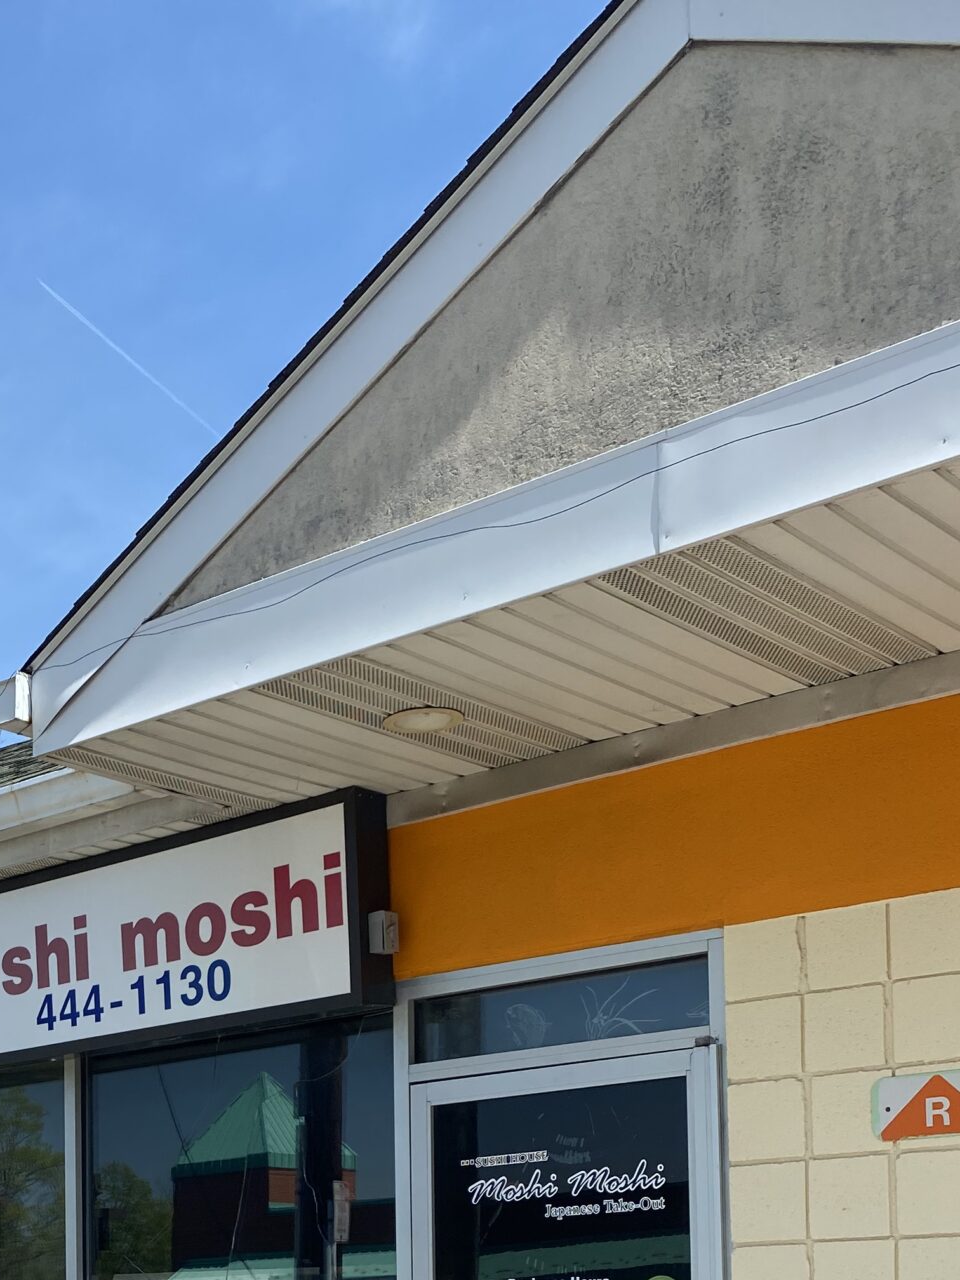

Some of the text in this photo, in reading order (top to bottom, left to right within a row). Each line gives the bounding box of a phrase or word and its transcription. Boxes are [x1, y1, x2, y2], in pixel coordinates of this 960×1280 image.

[121, 851, 346, 965] moshi
[35, 960, 232, 1032] 444-1130
[925, 1096, 951, 1128] R
[475, 1149, 549, 1168] SUSHI HOUSE
[468, 1159, 666, 1205] Moshi Moshi
[545, 1197, 666, 1220] Japanese Take-Out
